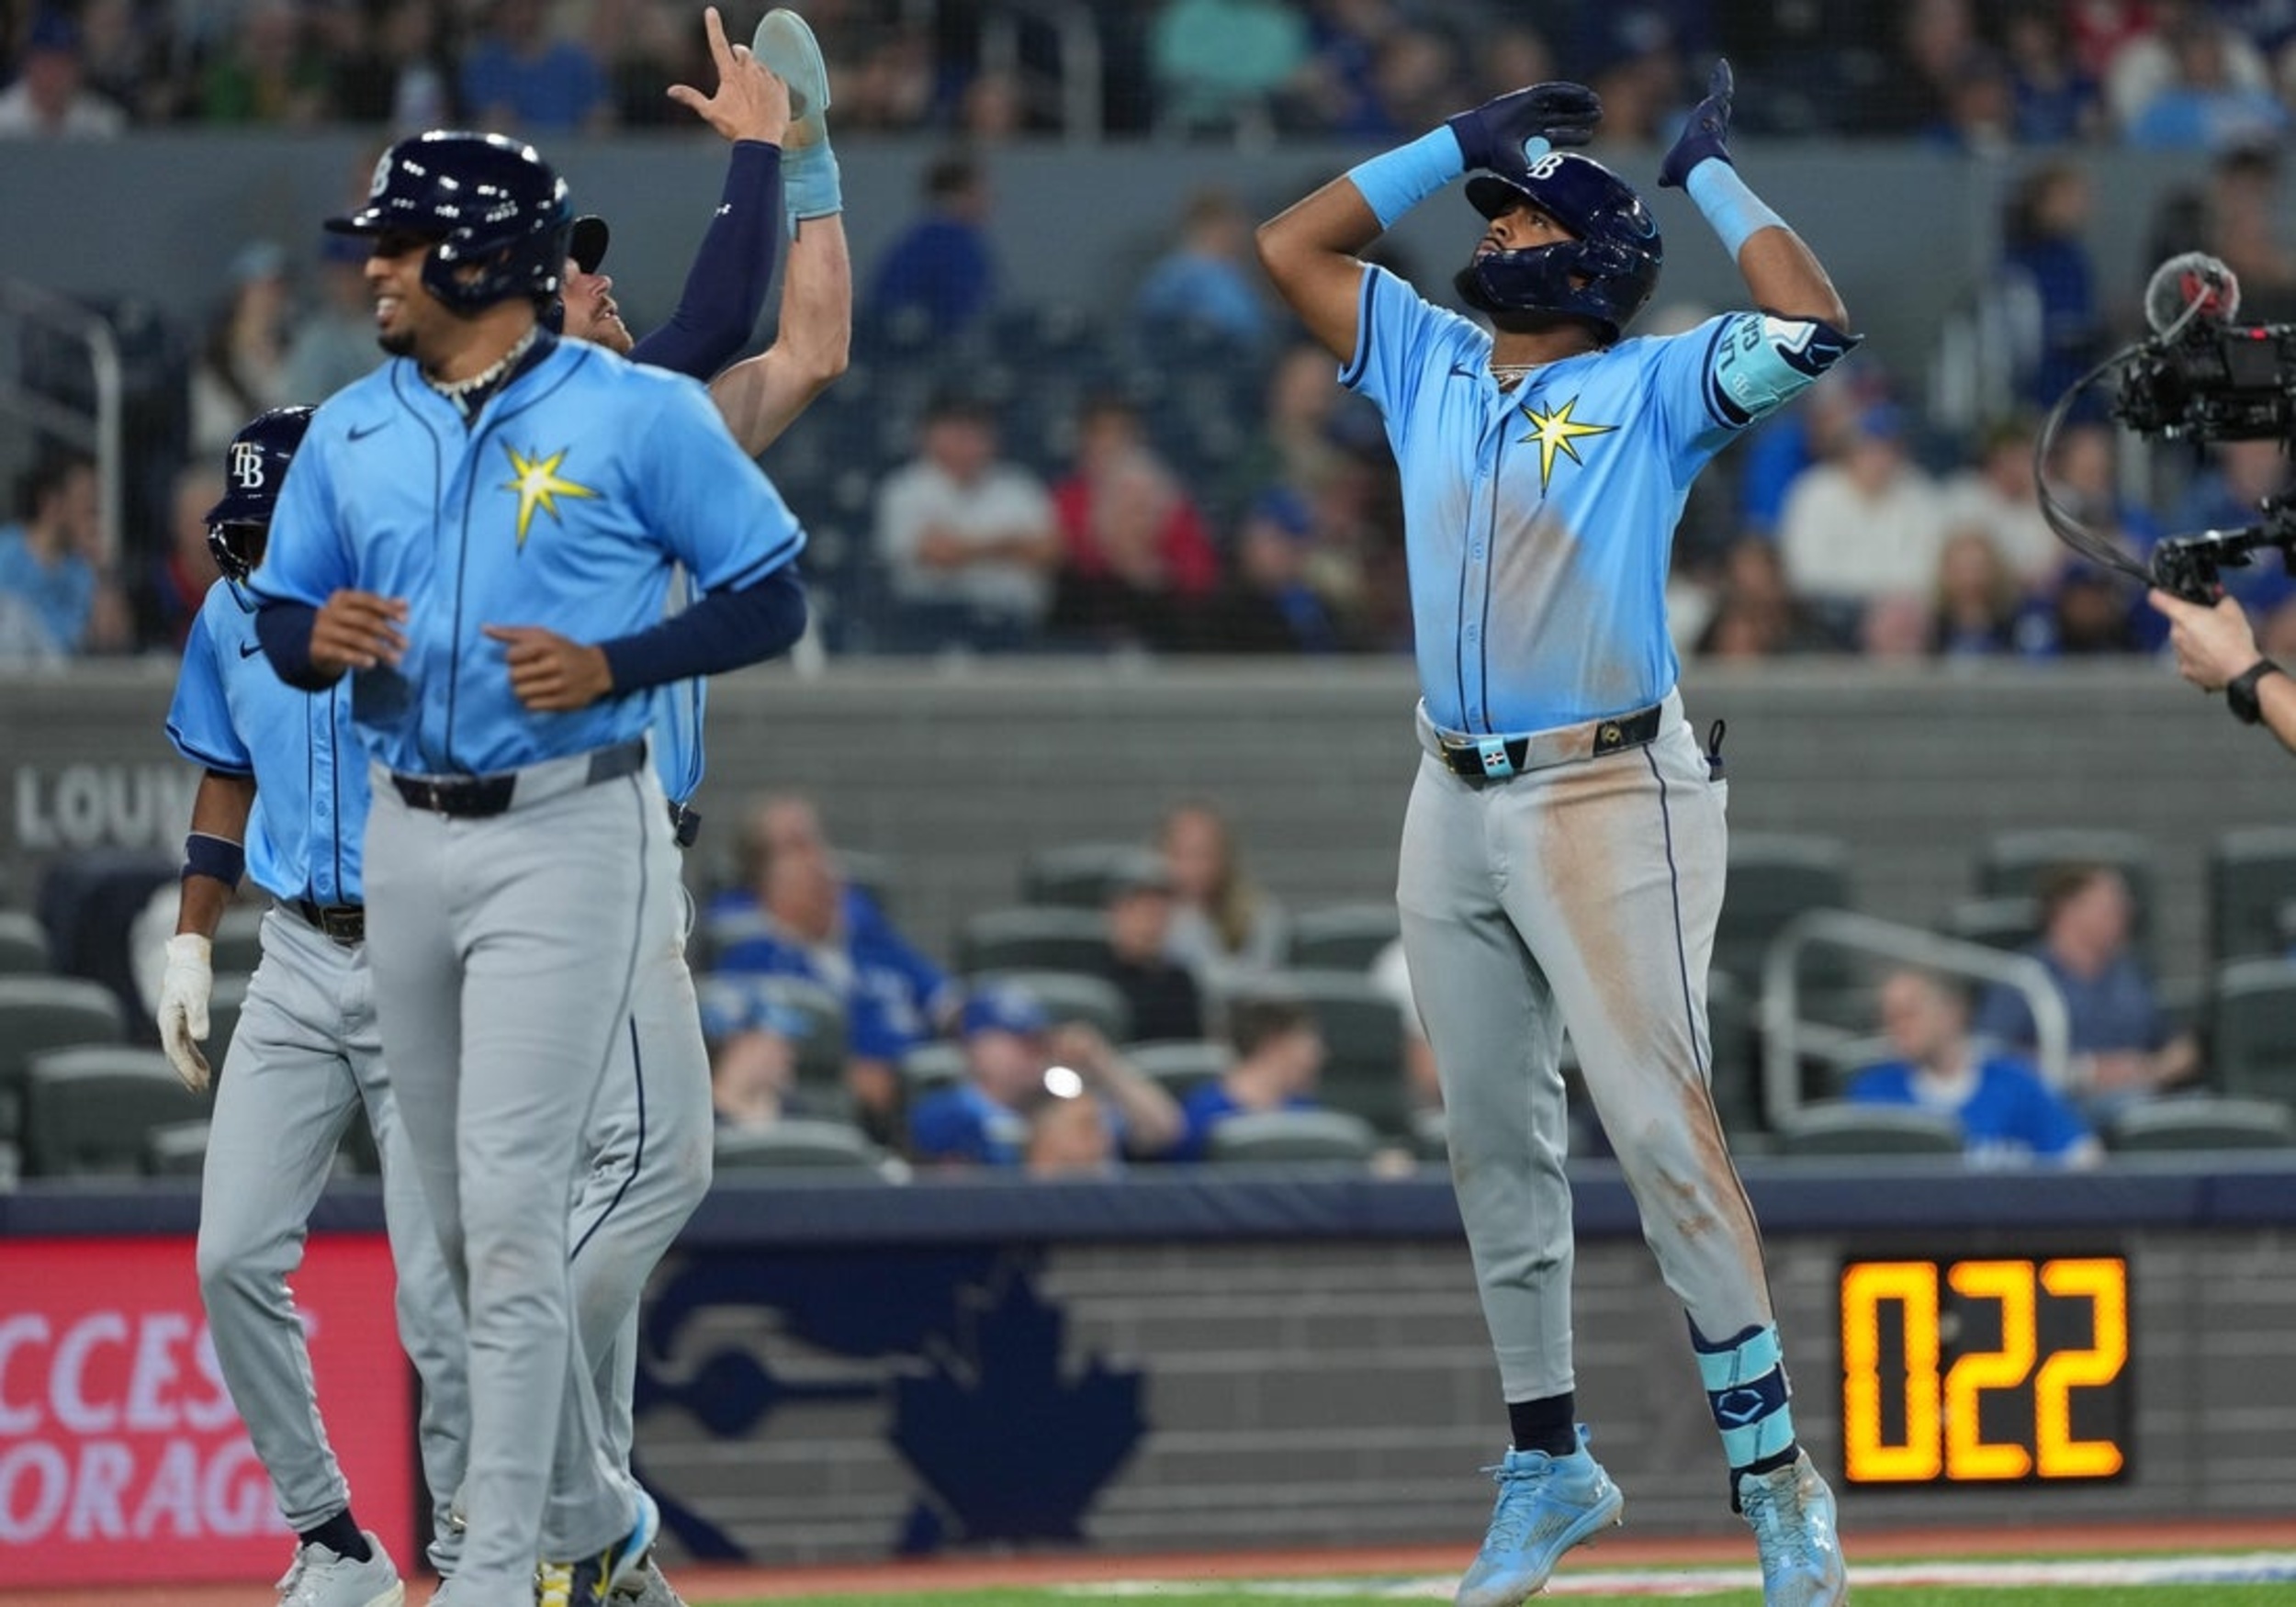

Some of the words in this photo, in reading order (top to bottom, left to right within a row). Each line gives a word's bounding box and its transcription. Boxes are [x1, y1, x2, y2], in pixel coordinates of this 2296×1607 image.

[369, 146, 393, 197] B
[1526, 152, 1564, 180] B
[231, 442, 264, 489] TB
[0, 1309, 318, 1436] CCES
[1840, 1257, 2128, 1482] 022
